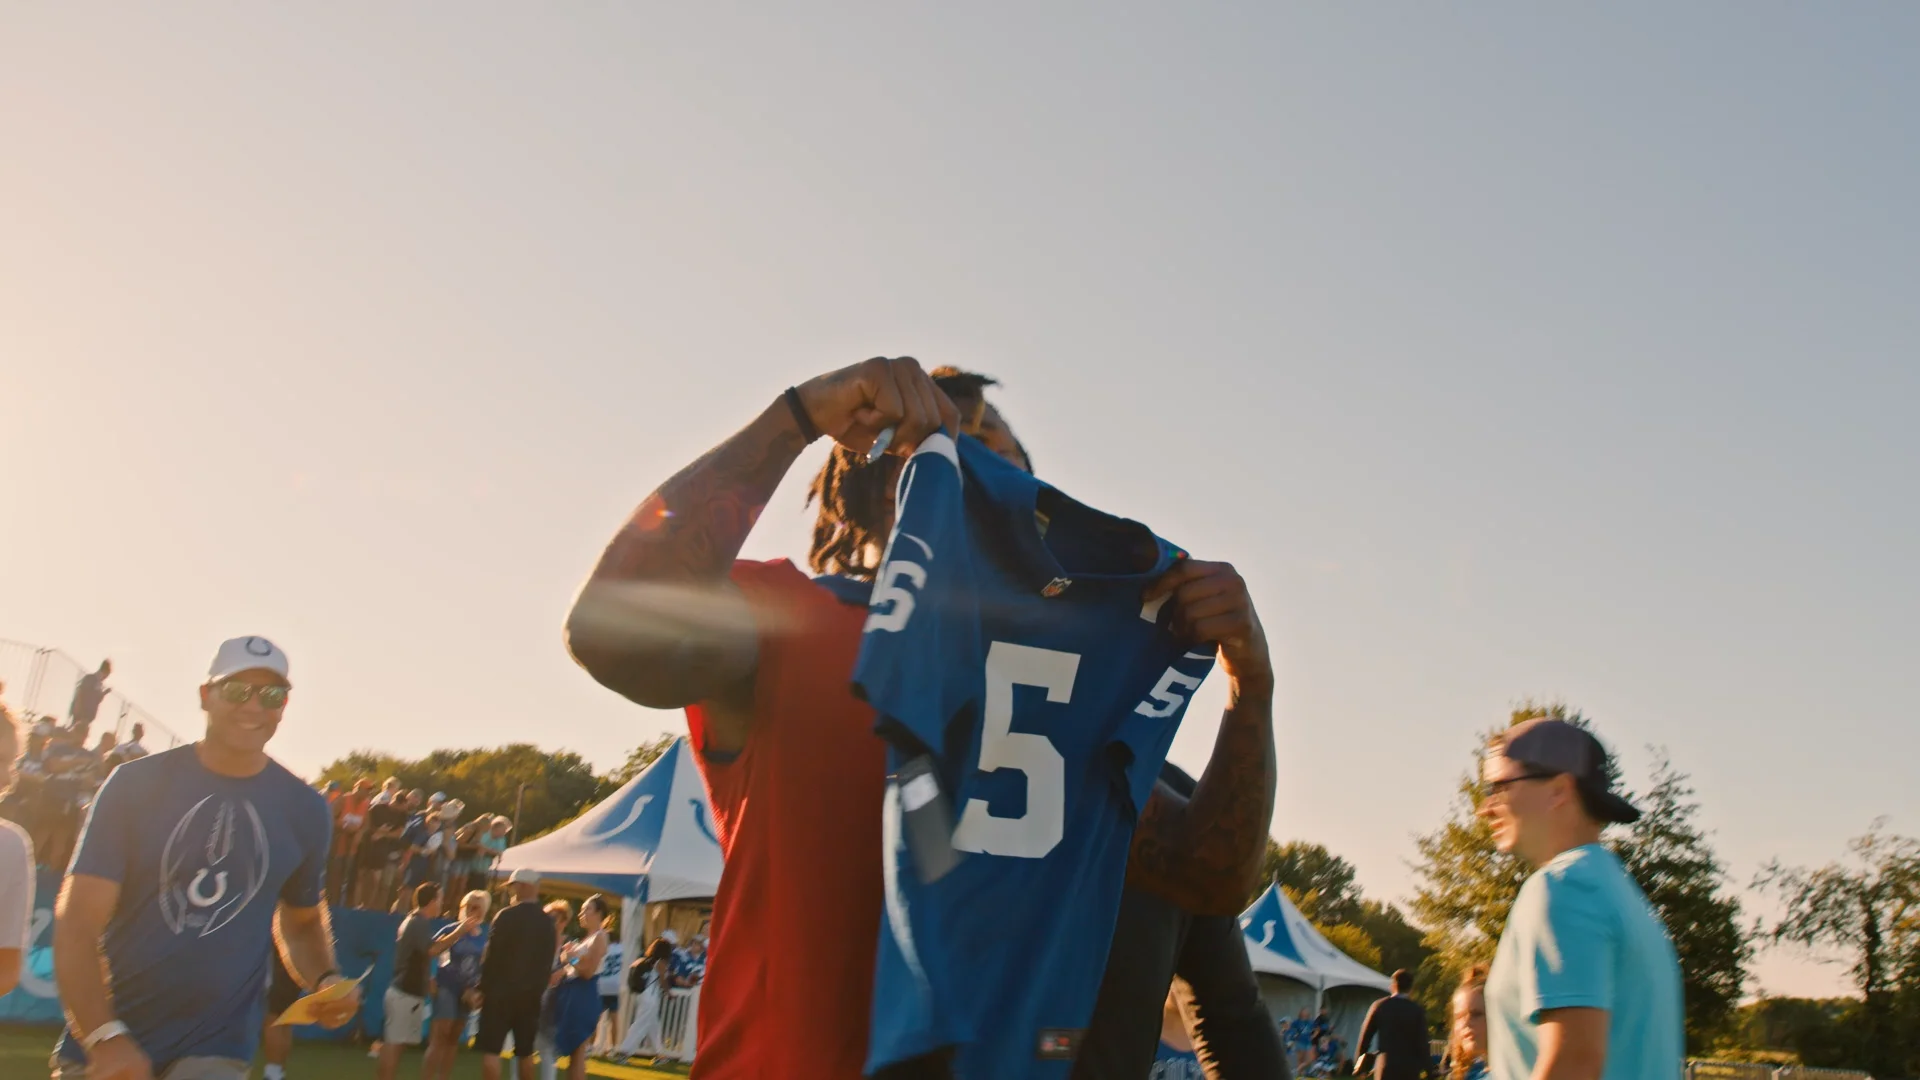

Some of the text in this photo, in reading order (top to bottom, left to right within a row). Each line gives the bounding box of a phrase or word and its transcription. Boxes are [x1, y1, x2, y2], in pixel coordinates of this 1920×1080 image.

[864, 561, 927, 632] 5
[1134, 666, 1202, 717] 5
[952, 641, 1081, 858] 5
